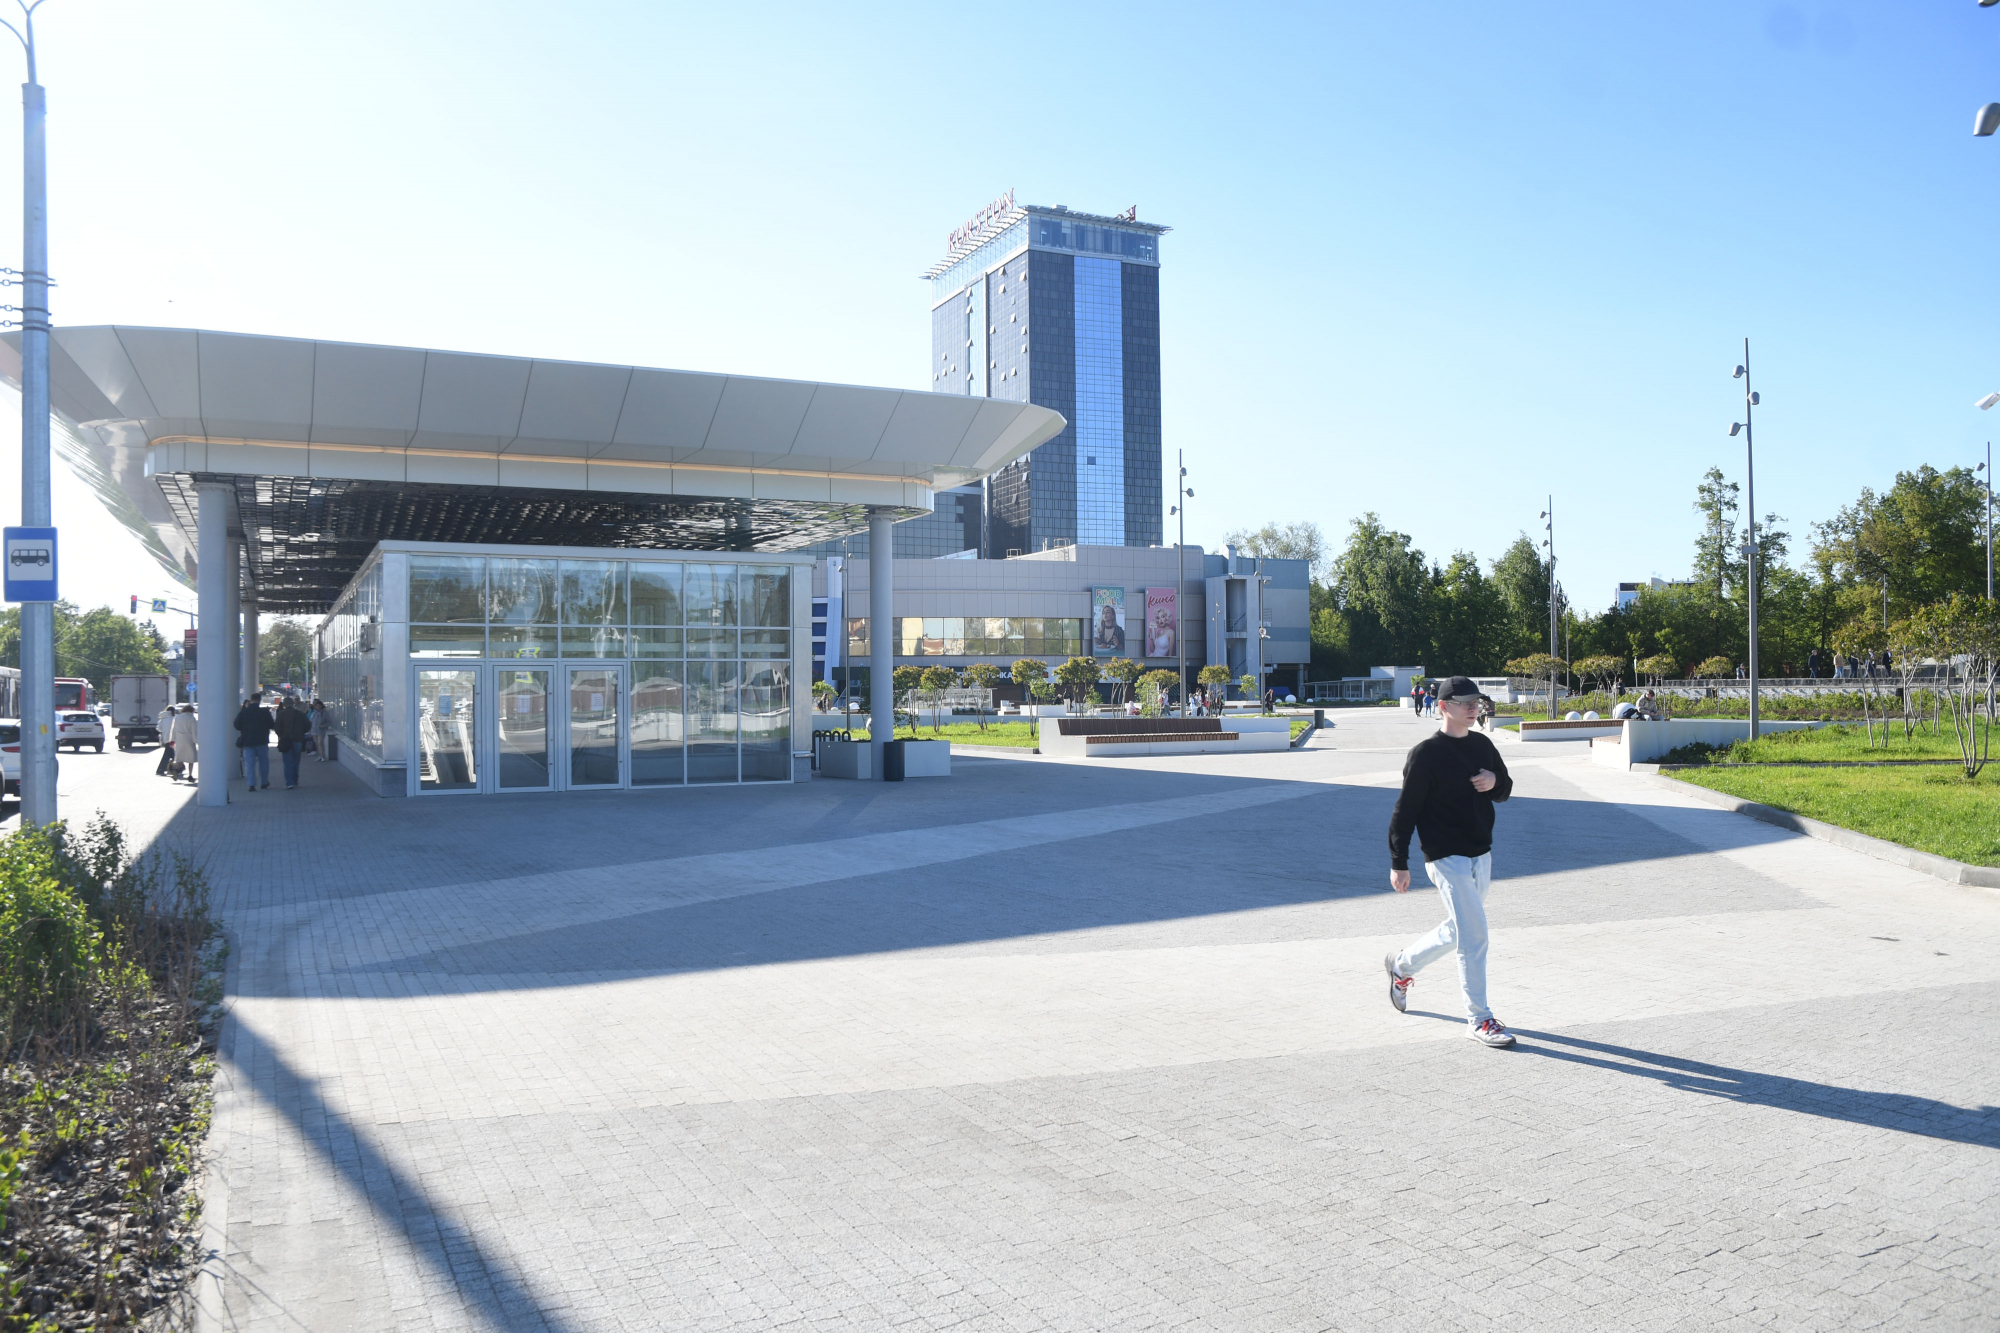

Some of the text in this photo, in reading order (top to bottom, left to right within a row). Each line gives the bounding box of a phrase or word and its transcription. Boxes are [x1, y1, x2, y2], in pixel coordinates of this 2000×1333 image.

[947, 187, 1014, 252] KORSTON
[1096, 589, 1122, 598] FOOD
[1096, 598, 1122, 606] MALL
